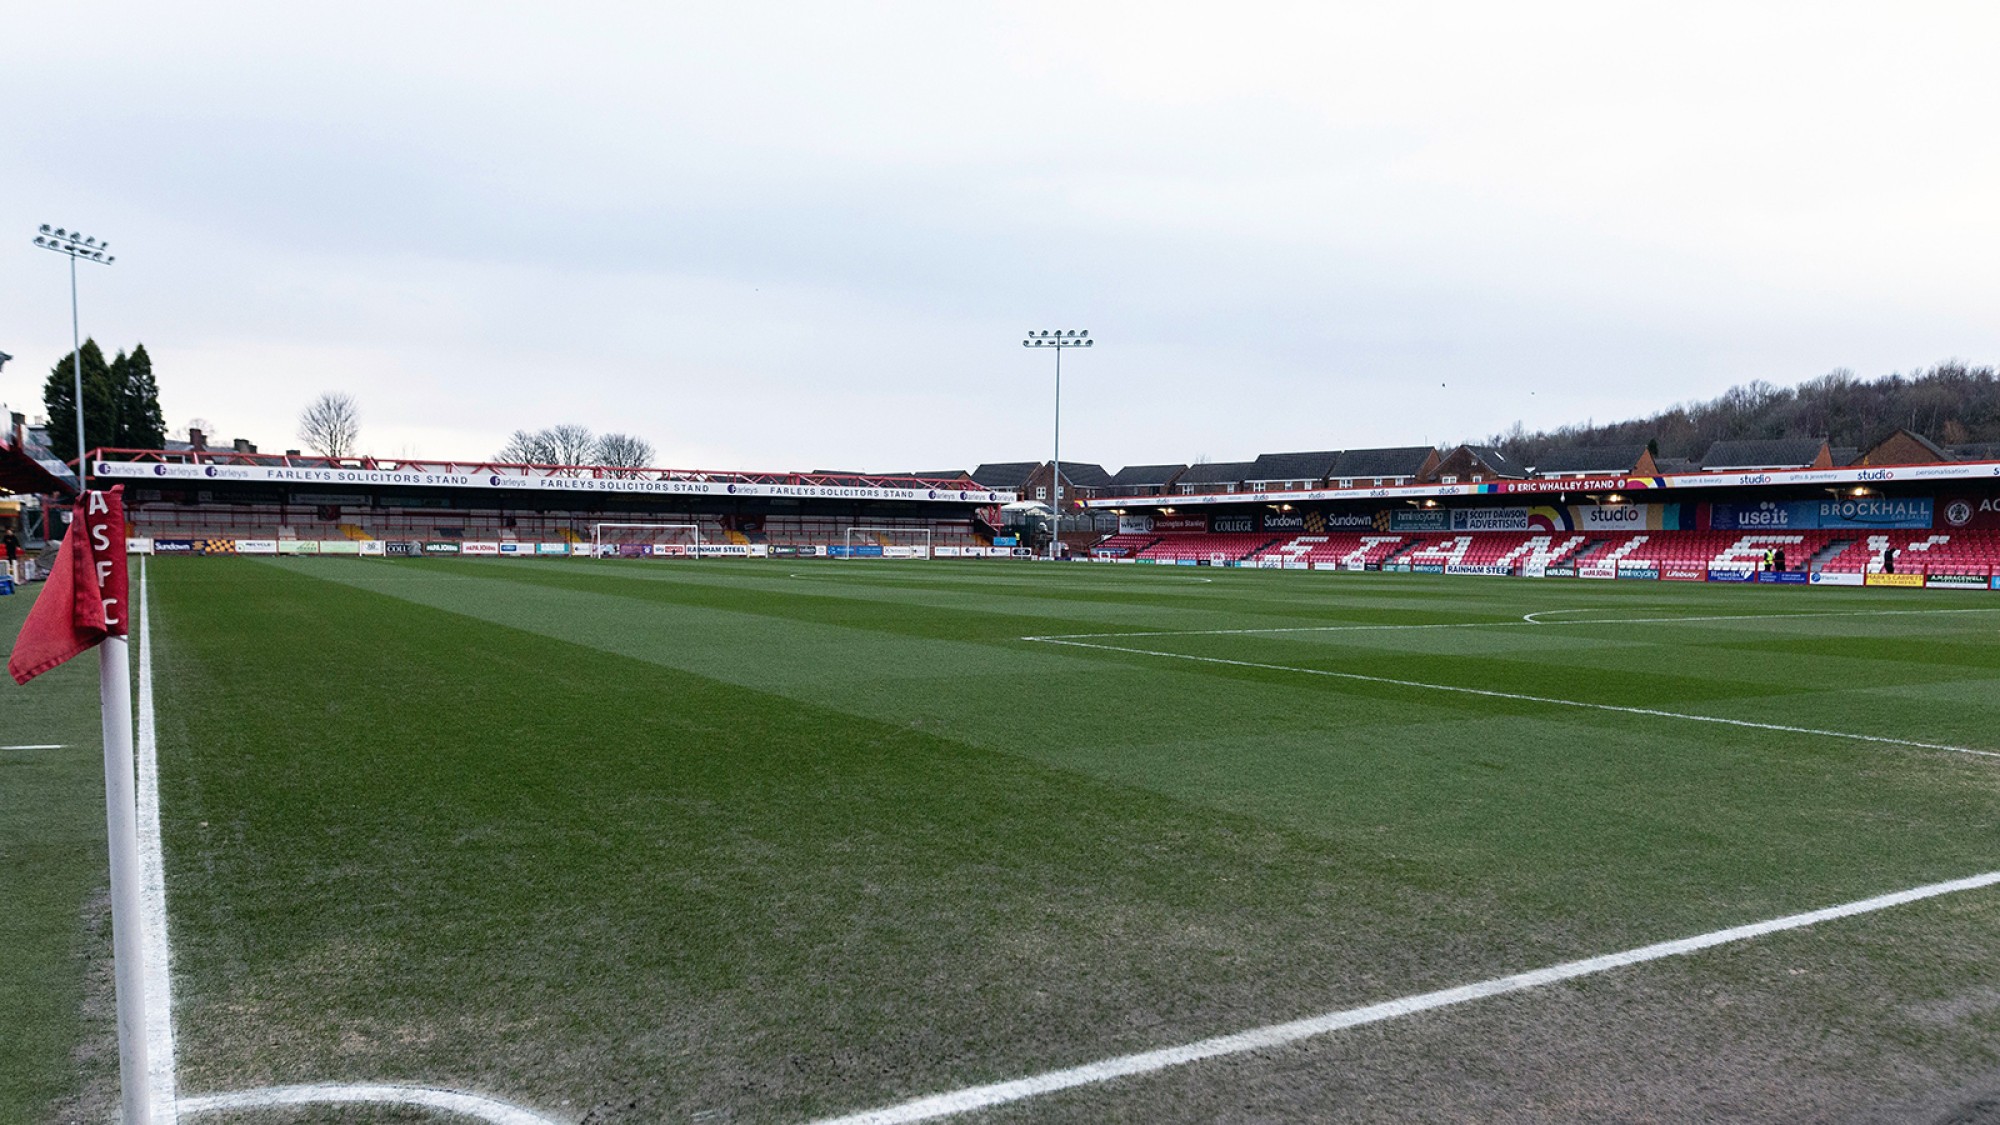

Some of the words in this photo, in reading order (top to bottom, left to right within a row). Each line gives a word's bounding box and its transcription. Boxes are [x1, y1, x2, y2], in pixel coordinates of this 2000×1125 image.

[1858, 470, 1894, 480] studio
[1916, 468, 1970, 476] personalisation
[267, 470, 331, 480] FARLEYS
[338, 472, 420, 484] SOLICITORS
[426, 475, 468, 485] STAND
[1740, 474, 1772, 484] studio
[540, 480, 594, 489] FARLEYS
[600, 482, 669, 491] SOLICITORS
[674, 484, 710, 492] STAND
[1438, 486, 1460, 495] studio
[1518, 482, 1536, 491] ERIC
[1540, 481, 1582, 490] WHALLEY
[1584, 480, 1614, 490] STAND
[770, 486, 816, 496] FARLEYS
[820, 488, 880, 498] SOLICITORS
[884, 490, 914, 498] STAND
[1370, 488, 1390, 497] studio
[1590, 506, 1638, 522] studio
[1820, 502, 1930, 516] BROCKHALL
[1329, 514, 1372, 526] Sundown
[1470, 510, 1492, 520] SCOTT
[1494, 510, 1526, 518] DAWSON
[1156, 520, 1184, 528] Accrington
[1185, 520, 1206, 528] Stanley
[1264, 514, 1302, 527] Sundown
[1470, 518, 1526, 529] ADVERTISING
[1214, 520, 1253, 532] COLLEGE
[155, 542, 190, 551] Sundown
[1447, 566, 1484, 574] RAINHAM
[1486, 566, 1510, 574] STEE
[1666, 570, 1700, 578] Lifebuoy
